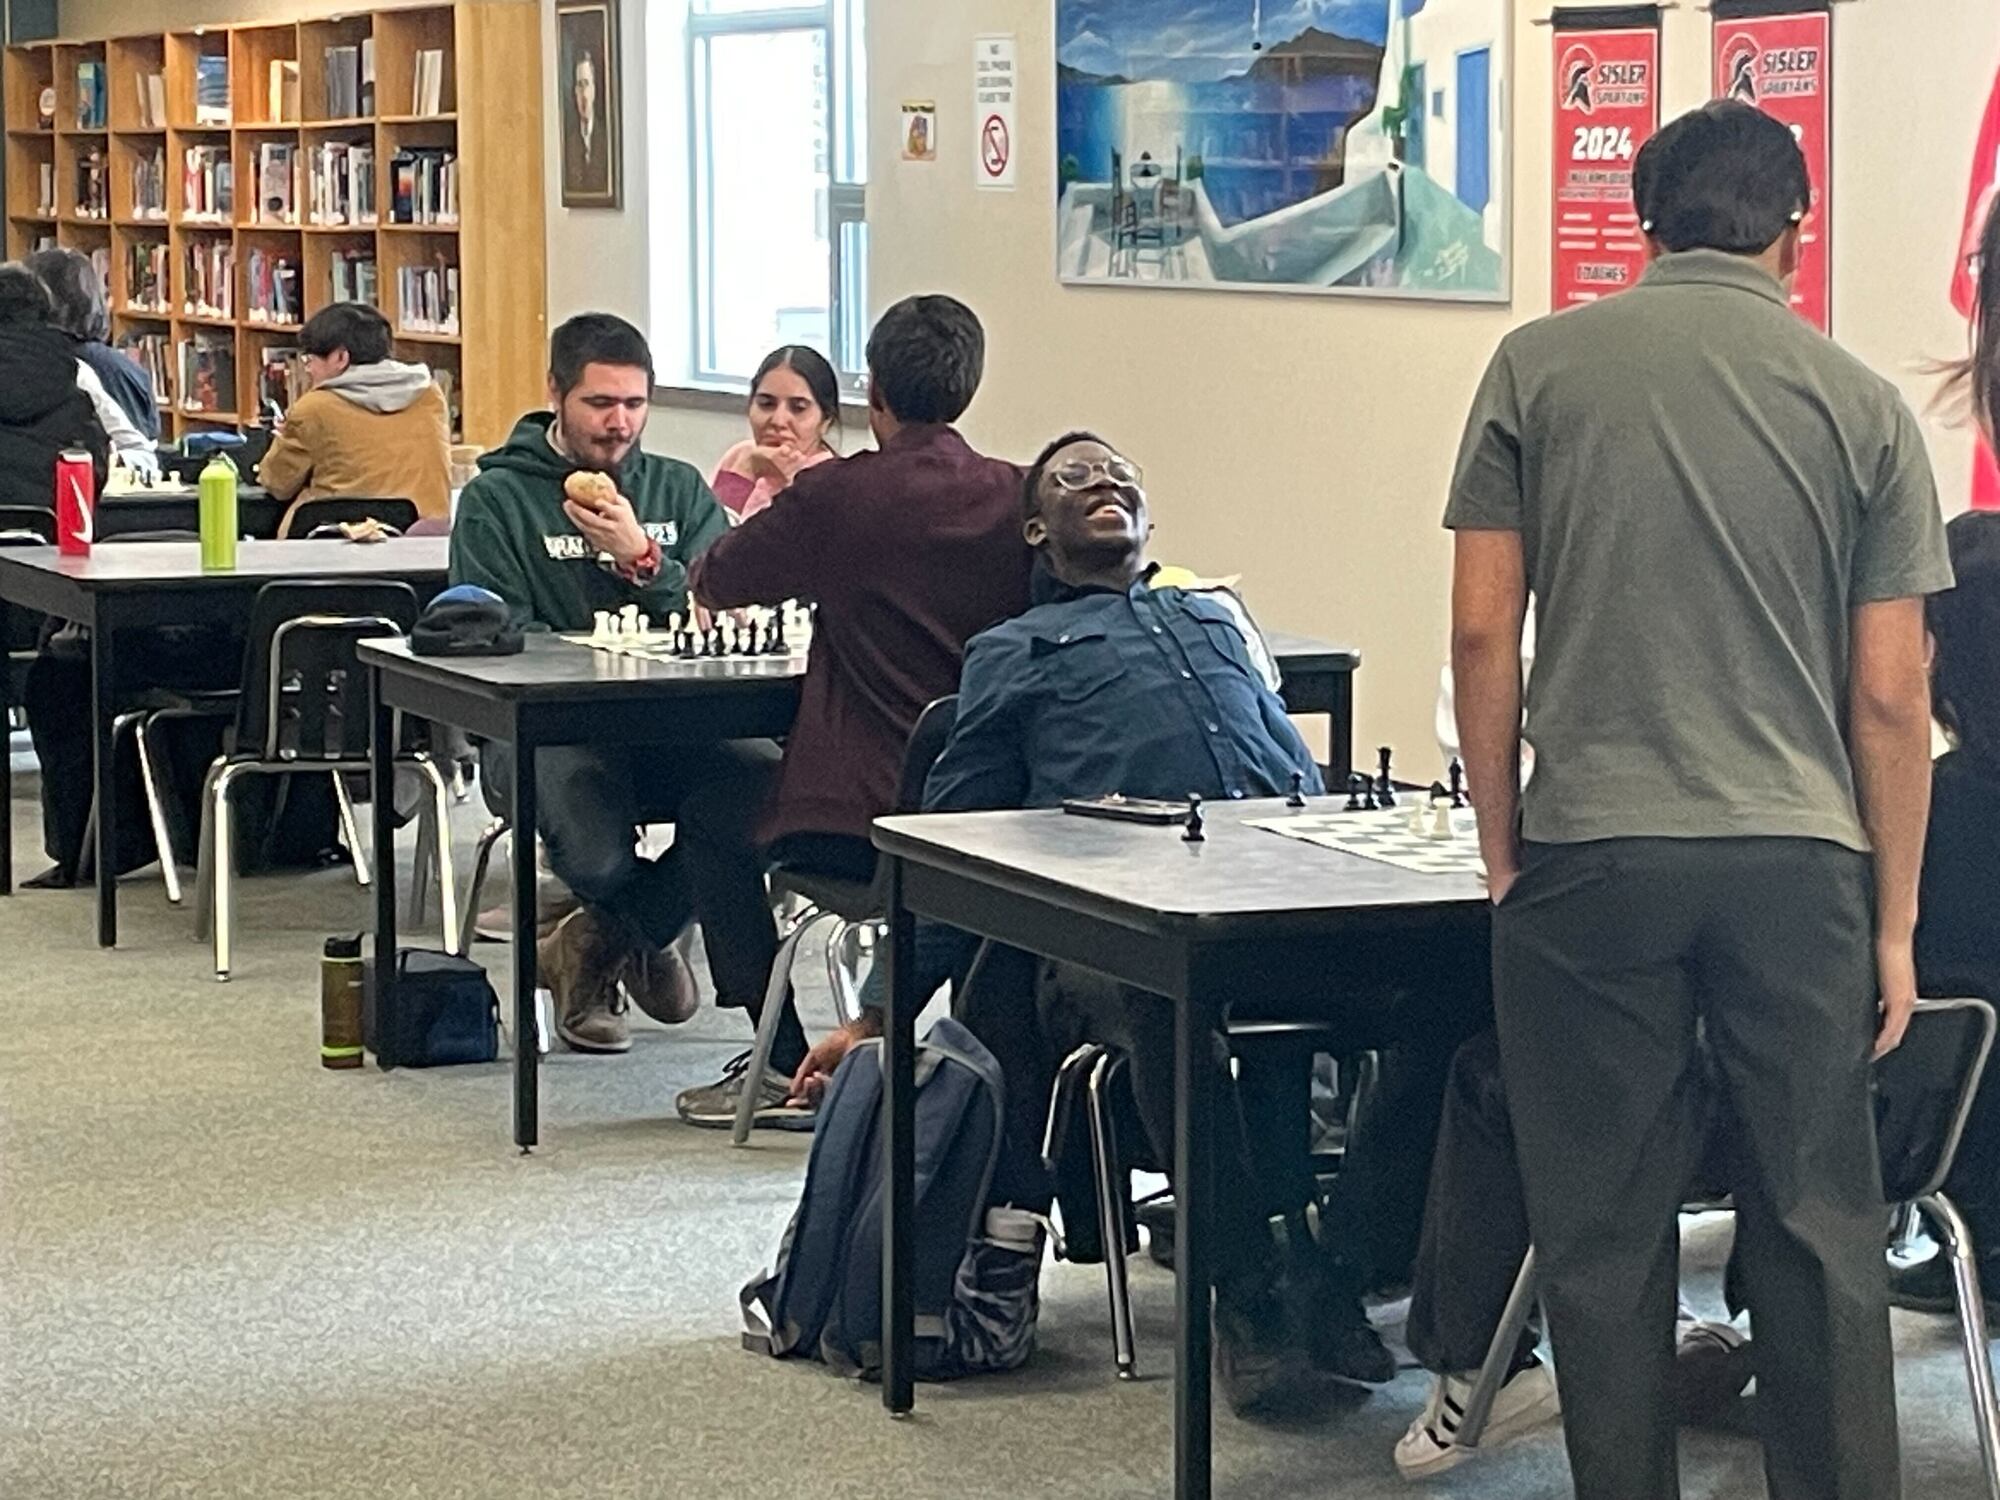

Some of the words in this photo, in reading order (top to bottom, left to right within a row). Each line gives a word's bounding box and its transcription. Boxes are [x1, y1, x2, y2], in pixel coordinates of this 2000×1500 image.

[1598, 64, 1647, 84] SISLER
[1763, 50, 1817, 74] SISLER
[1571, 126, 1634, 161] 2024
